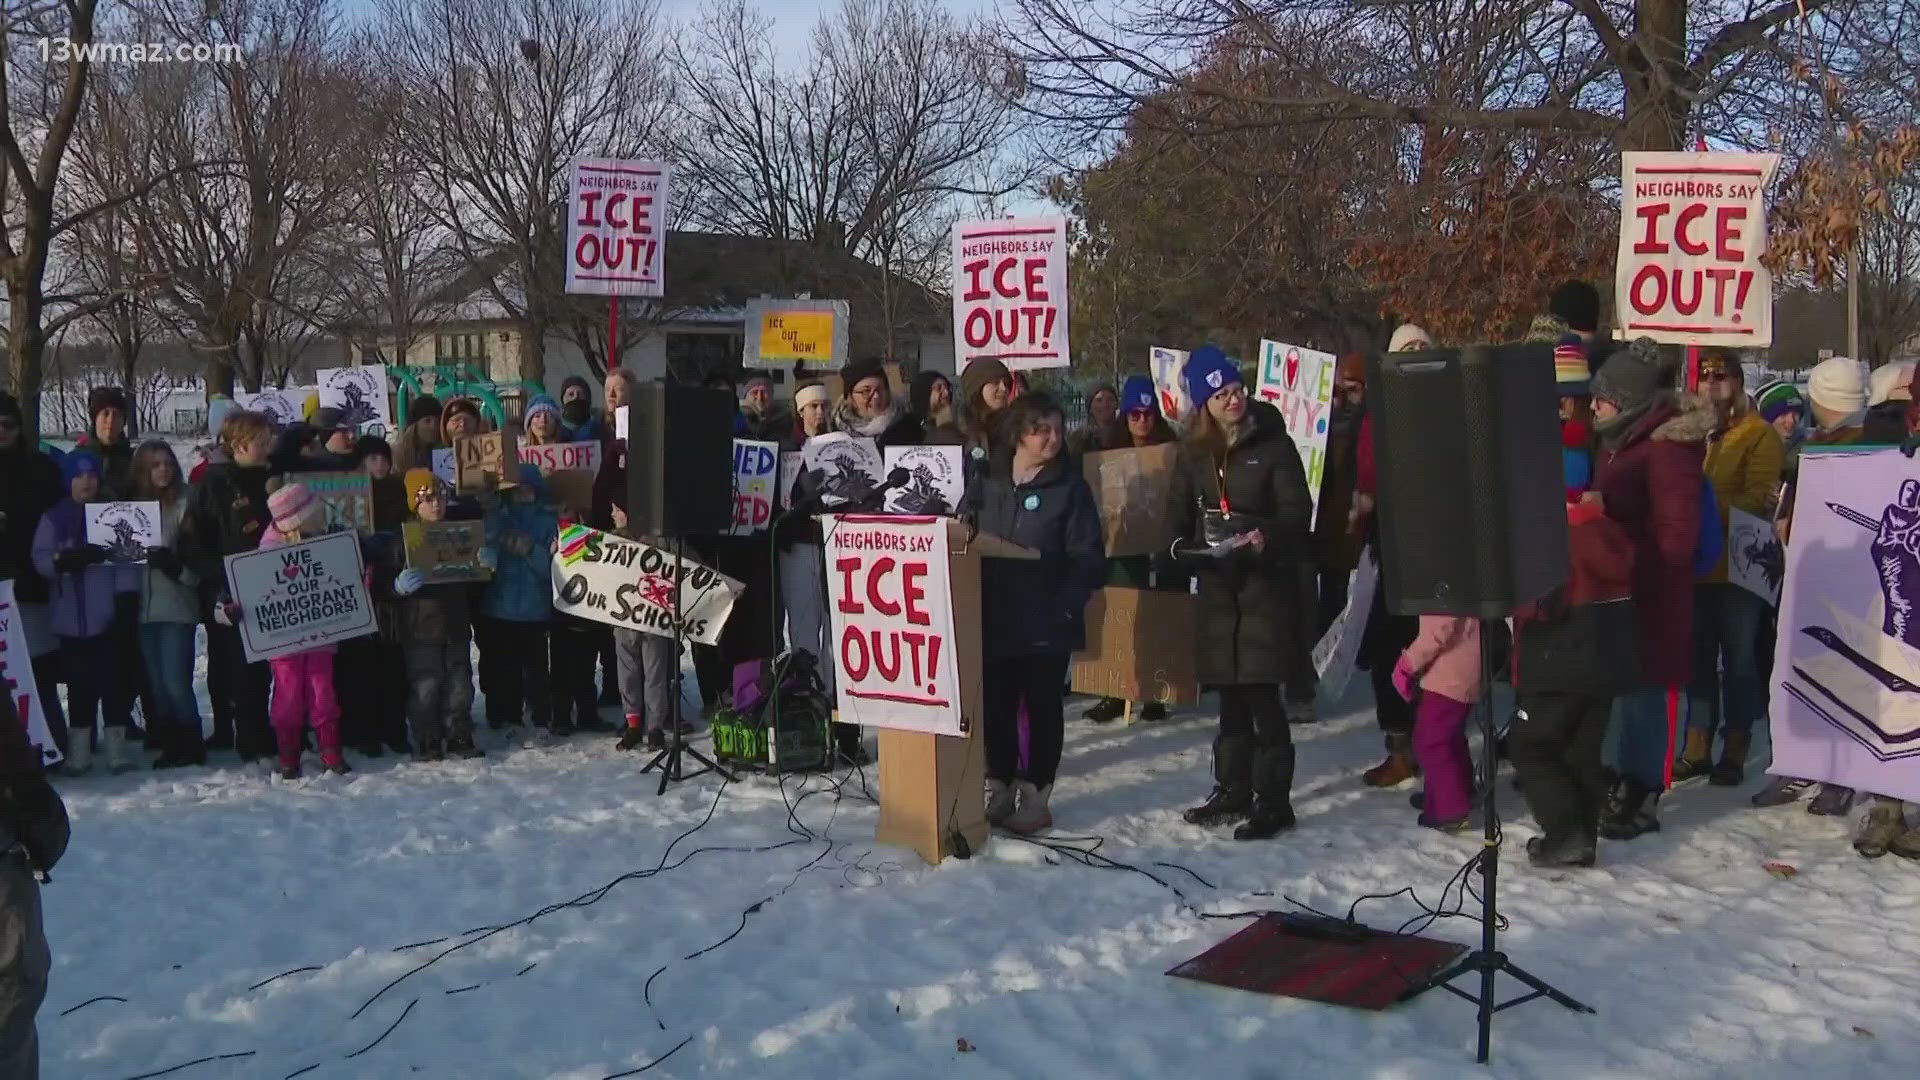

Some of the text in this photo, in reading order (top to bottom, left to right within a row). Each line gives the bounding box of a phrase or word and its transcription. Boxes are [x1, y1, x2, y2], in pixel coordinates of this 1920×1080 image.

[579, 177, 658, 191] NEIGHBORS SAY
[1636, 182, 1757, 200] NEIGHBORS SAY
[577, 191, 653, 234] ICE
[963, 240, 1053, 258] NEIGHBORS SAY
[1634, 203, 1747, 262] ICE
[575, 233, 657, 276] OUT!
[963, 257, 1049, 302] ICE
[1630, 264, 1754, 324] OUT!
[781, 330, 798, 341] OUT
[964, 307, 1056, 349] OUT!
[792, 342, 816, 353] NOW!
[563, 446, 594, 468] OFF
[280, 550, 312, 565] WE
[581, 533, 639, 568] STAY
[835, 531, 934, 552] NEIGHBORS SAY
[255, 584, 355, 620] IMMIGRANT
[287, 579, 319, 595] OUR
[561, 574, 607, 610] OUR
[836, 556, 930, 625] ICE
[258, 599, 358, 633] NEIGHBORS!
[841, 624, 942, 696] OUT!
